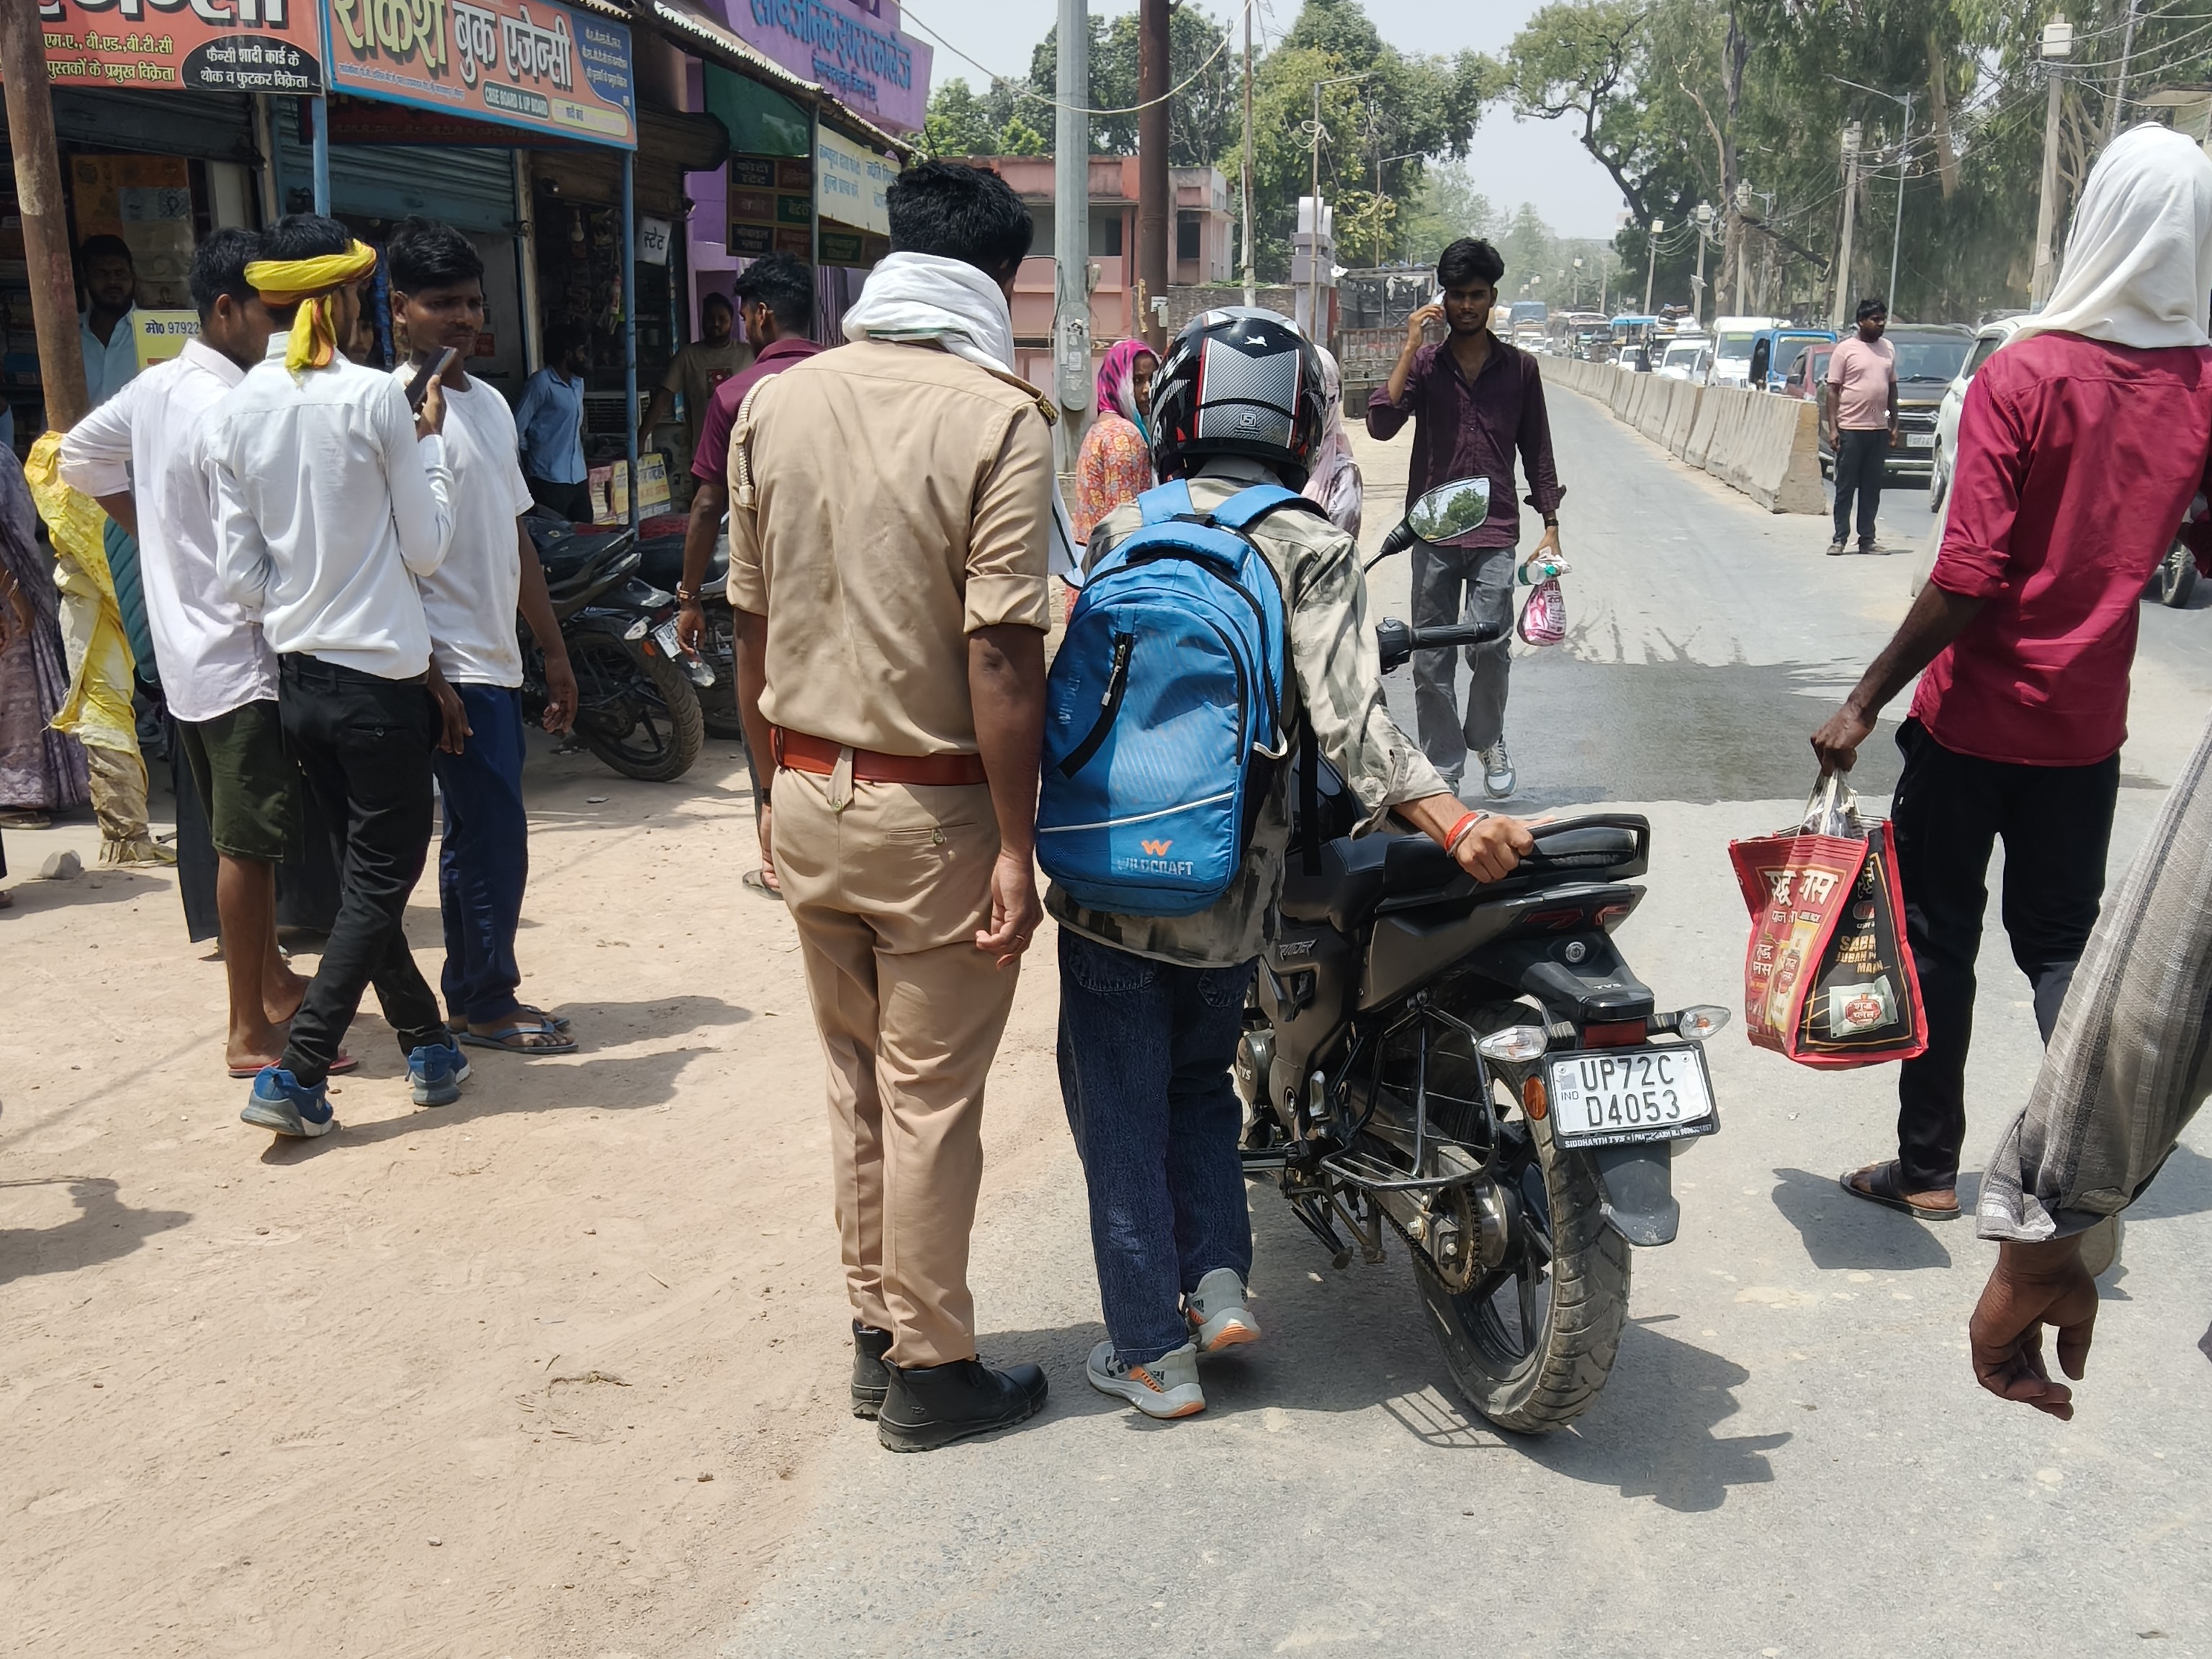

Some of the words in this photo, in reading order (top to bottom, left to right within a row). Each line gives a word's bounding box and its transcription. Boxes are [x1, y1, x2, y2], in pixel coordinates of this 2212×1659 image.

[239, 45, 262, 63] शादी
[265, 45, 286, 65] कार्ड
[287, 51, 300, 66] के
[451, 1, 497, 83] बुक
[500, 4, 572, 86] एजेन्सी
[47, 58, 86, 79] पुस्तकों
[89, 59, 102, 76] के
[104, 63, 136, 84] प्रमुख
[138, 61, 175, 81] विक्रेता
[201, 67, 224, 83] थोक
[226, 71, 235, 84] व
[236, 72, 272, 89] फुटकर
[274, 70, 308, 89] विक्रेता
[644, 226, 665, 250] स्टेट
[1580, 1055, 1674, 1091] UP72C
[1560, 1091, 1579, 1101] IND
[1586, 1089, 1681, 1128] D4053
[1565, 1136, 1608, 1148] SIDDHARTH
[1608, 1136, 1625, 1144] TVS
